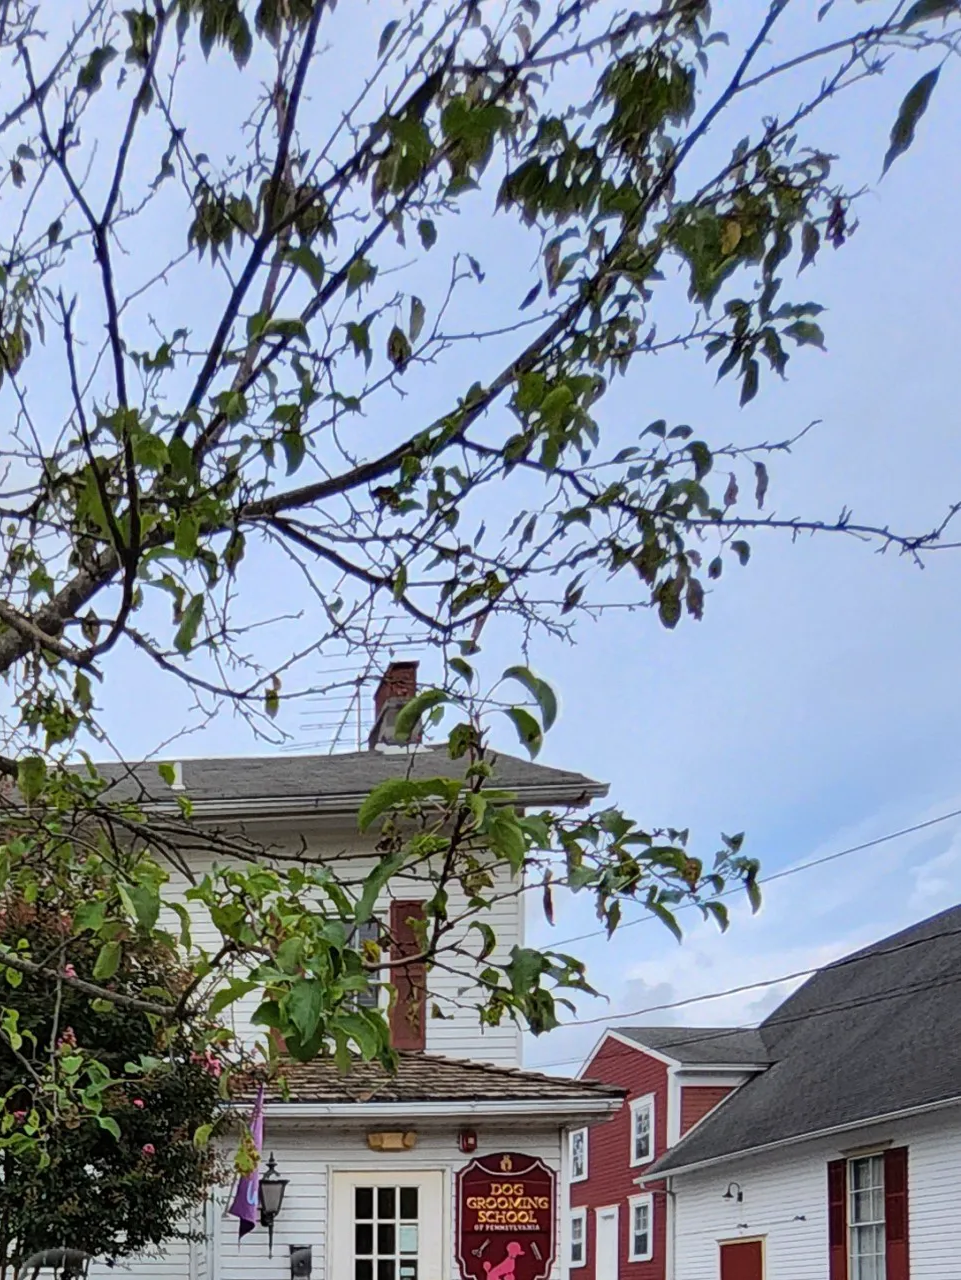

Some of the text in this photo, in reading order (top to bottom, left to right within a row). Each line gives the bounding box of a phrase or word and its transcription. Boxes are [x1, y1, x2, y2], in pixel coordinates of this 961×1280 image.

[490, 1183, 524, 1196] DOG
[466, 1197, 549, 1209] GROOMING
[477, 1210, 537, 1223] SCHOOL
